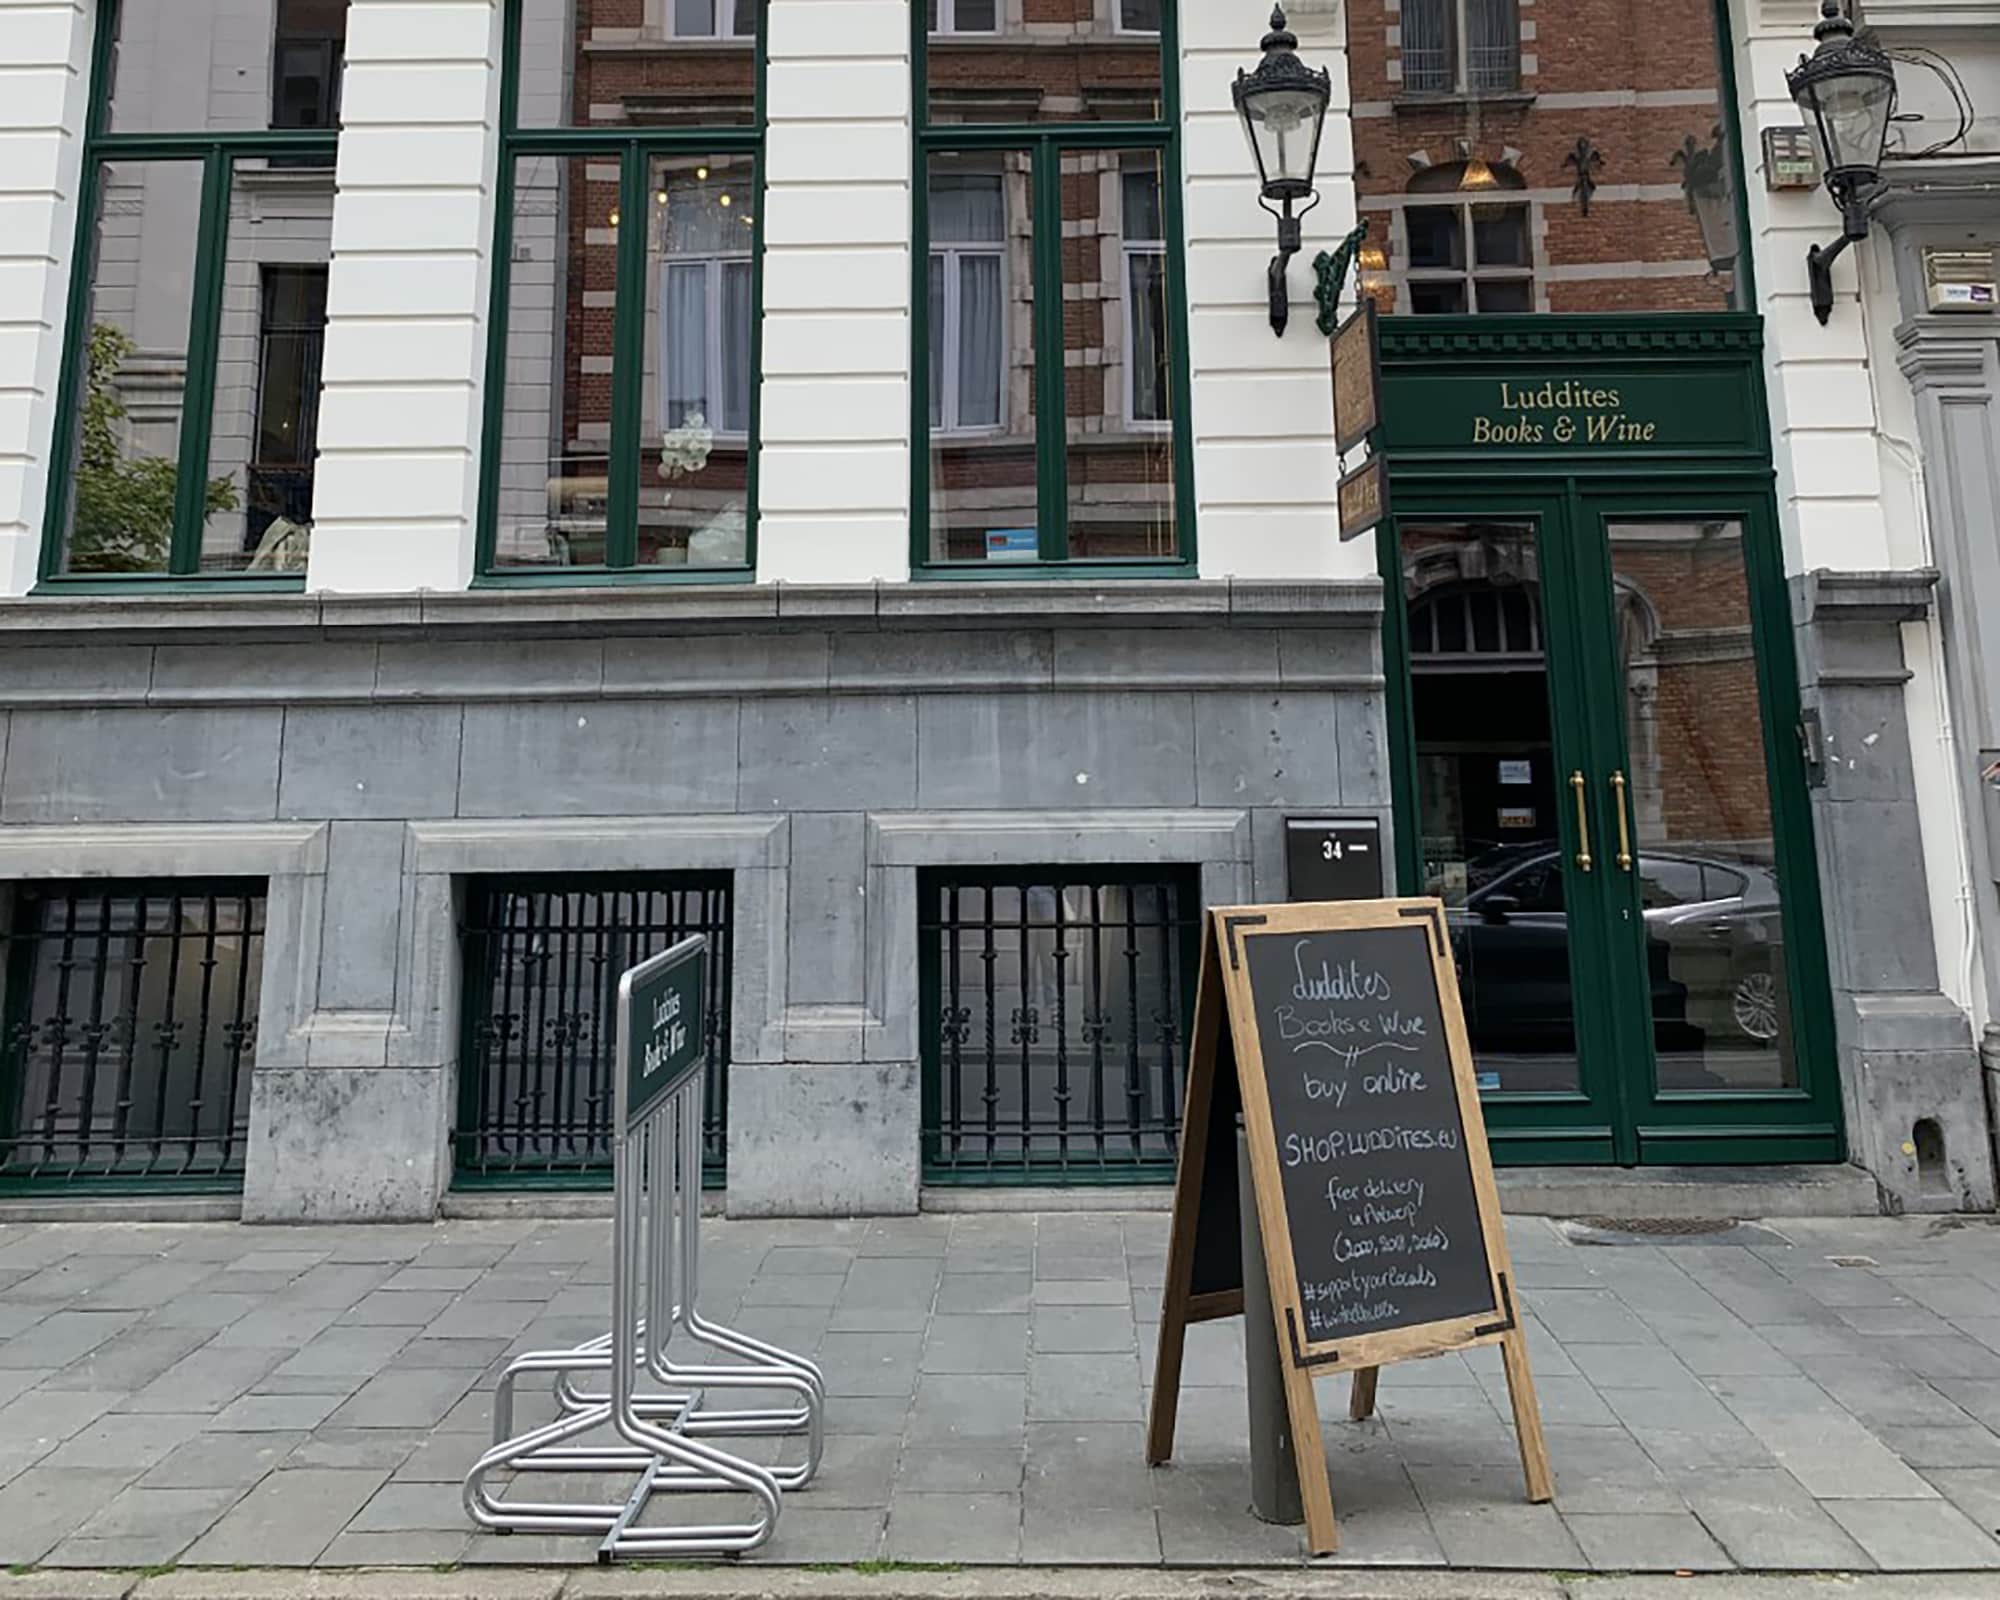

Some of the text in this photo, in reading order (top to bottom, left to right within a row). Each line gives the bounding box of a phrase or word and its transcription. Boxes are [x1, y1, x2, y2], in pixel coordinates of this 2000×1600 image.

[1501, 381, 1620, 409] Luddites
[1473, 414, 1655, 442] Books & Wine
[1323, 840, 1342, 859] 34
[1274, 1005, 1358, 1038] Books
[1303, 1061, 1428, 1108] buy online
[1364, 1178, 1425, 1207] delivery
